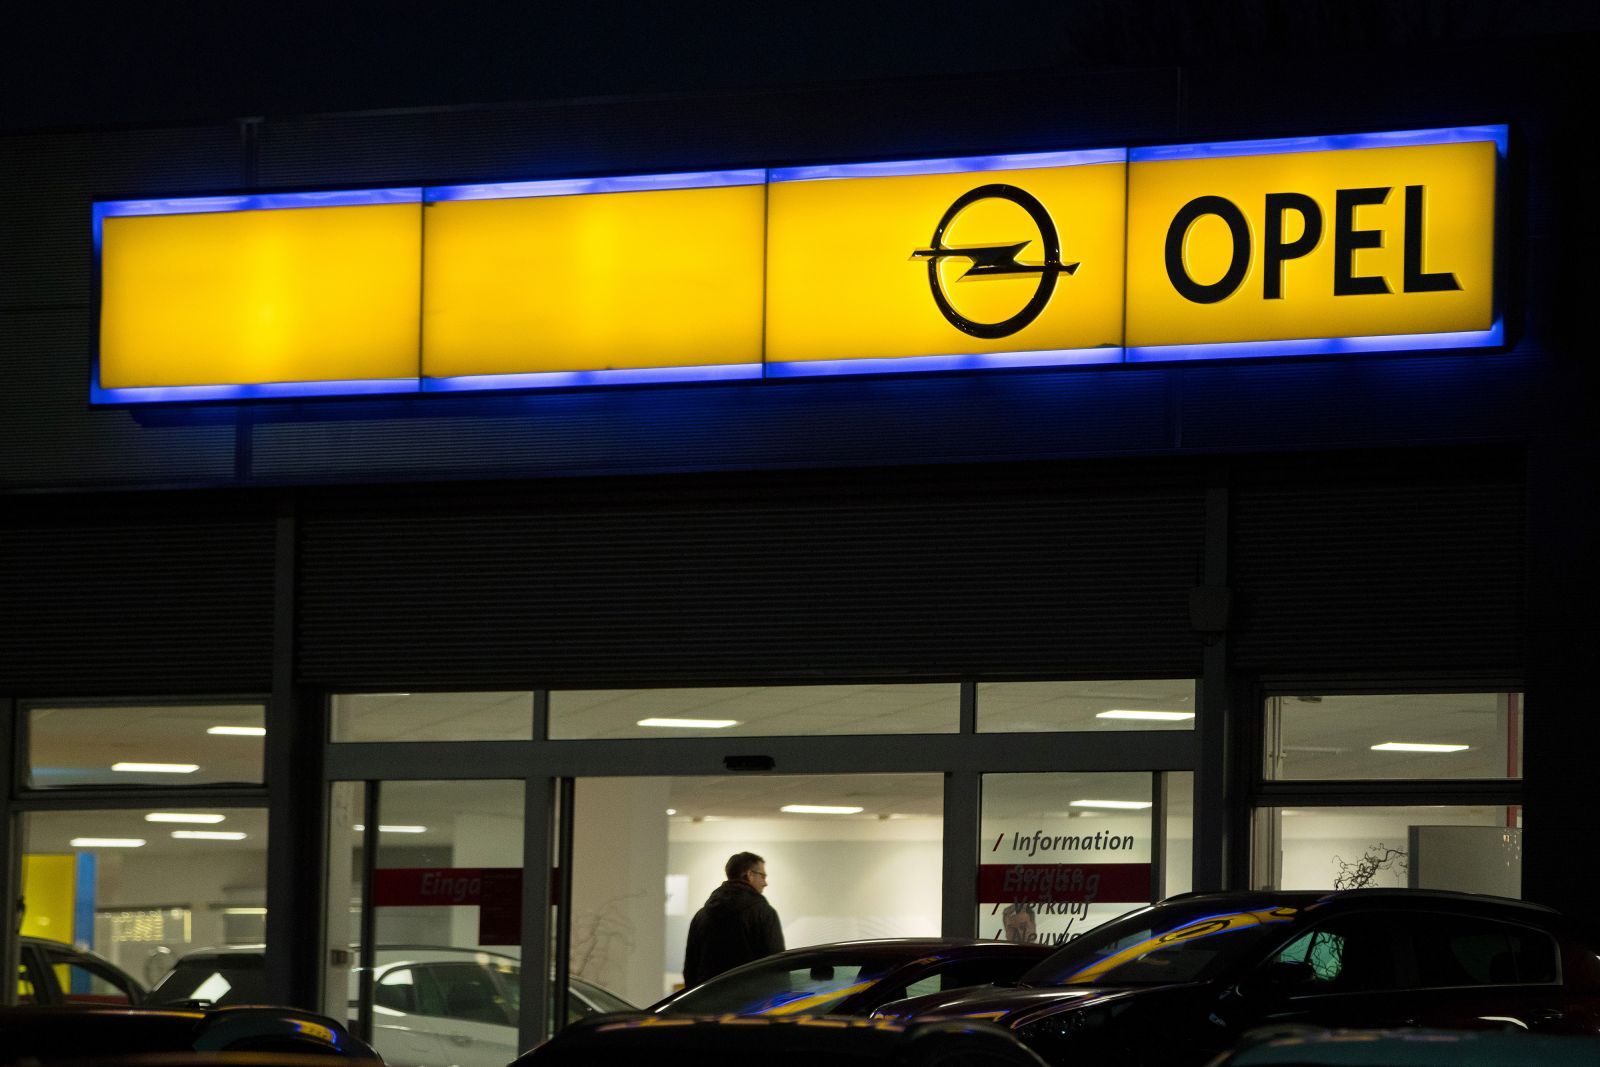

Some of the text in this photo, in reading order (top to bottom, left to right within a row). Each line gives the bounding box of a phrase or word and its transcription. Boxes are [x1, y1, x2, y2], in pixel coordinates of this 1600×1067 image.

[1165, 185, 1464, 304] OPEL
[1012, 830, 1134, 856] Information
[1013, 895, 1091, 921] Verkauf
